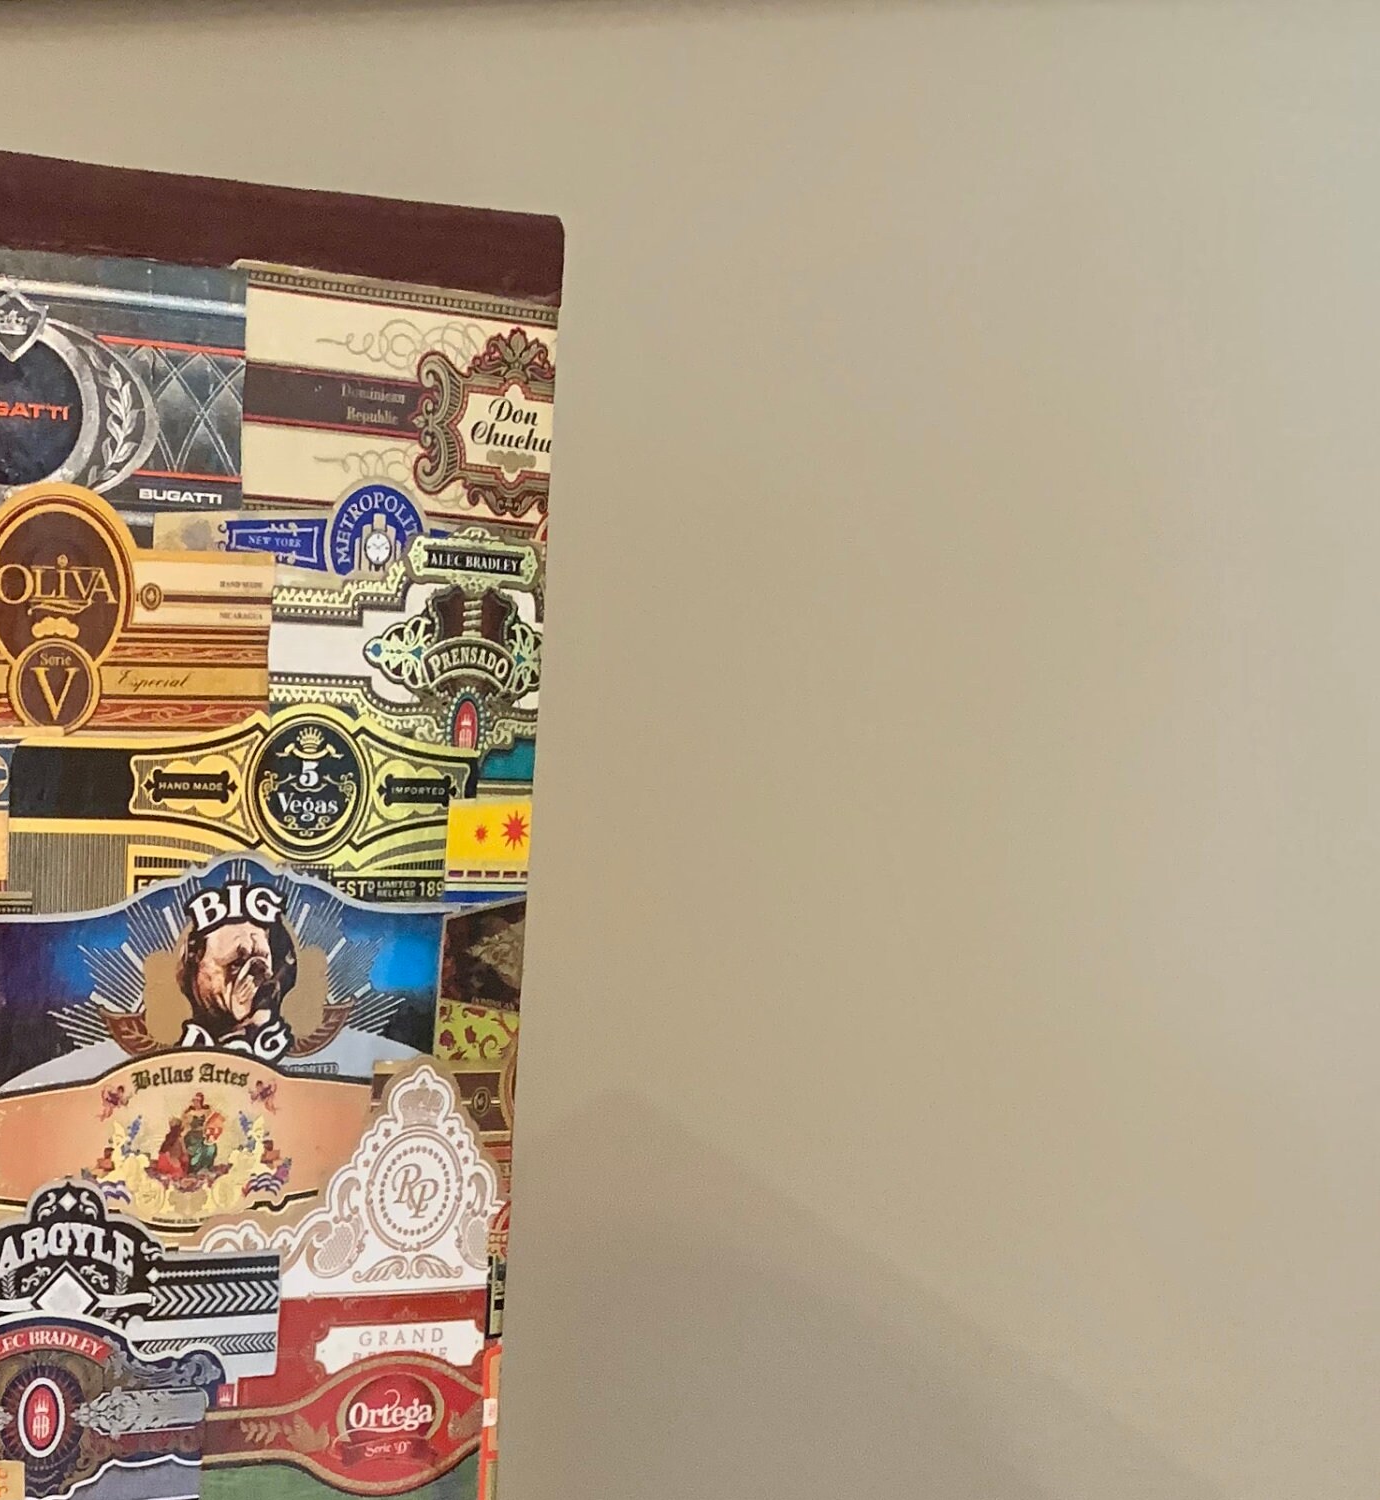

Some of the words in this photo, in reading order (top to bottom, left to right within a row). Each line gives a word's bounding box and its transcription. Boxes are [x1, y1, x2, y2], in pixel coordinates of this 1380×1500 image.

[341, 382, 405, 406] Dominican
[345, 405, 399, 427] Republic
[488, 398, 538, 427] Don
[138, 487, 222, 505] BUGATTI
[248, 534, 271, 547] NEW
[273, 535, 302, 549] YORK
[430, 553, 464, 569] ALEC
[465, 555, 520, 573] BRADLEY
[39, 651, 72, 667] Serie
[428, 647, 509, 680] PRENSADO
[116, 668, 191, 691] Especial
[31, 666, 80, 720] V
[298, 761, 319, 787] 5
[158, 781, 190, 791] HAND
[192, 782, 223, 792] MADE
[390, 786, 446, 797] IMPORTED
[277, 792, 339, 822] Vegas
[376, 881, 417, 890] LIMITED
[376, 889, 416, 898] RELEASE
[188, 884, 284, 932] BIG
[131, 1064, 194, 1092] Bellas
[199, 1063, 251, 1088] Artes
[28, 1330, 104, 1356] BRADLEY
[358, 1327, 444, 1347] GRAND
[348, 1389, 434, 1431] Ortega
